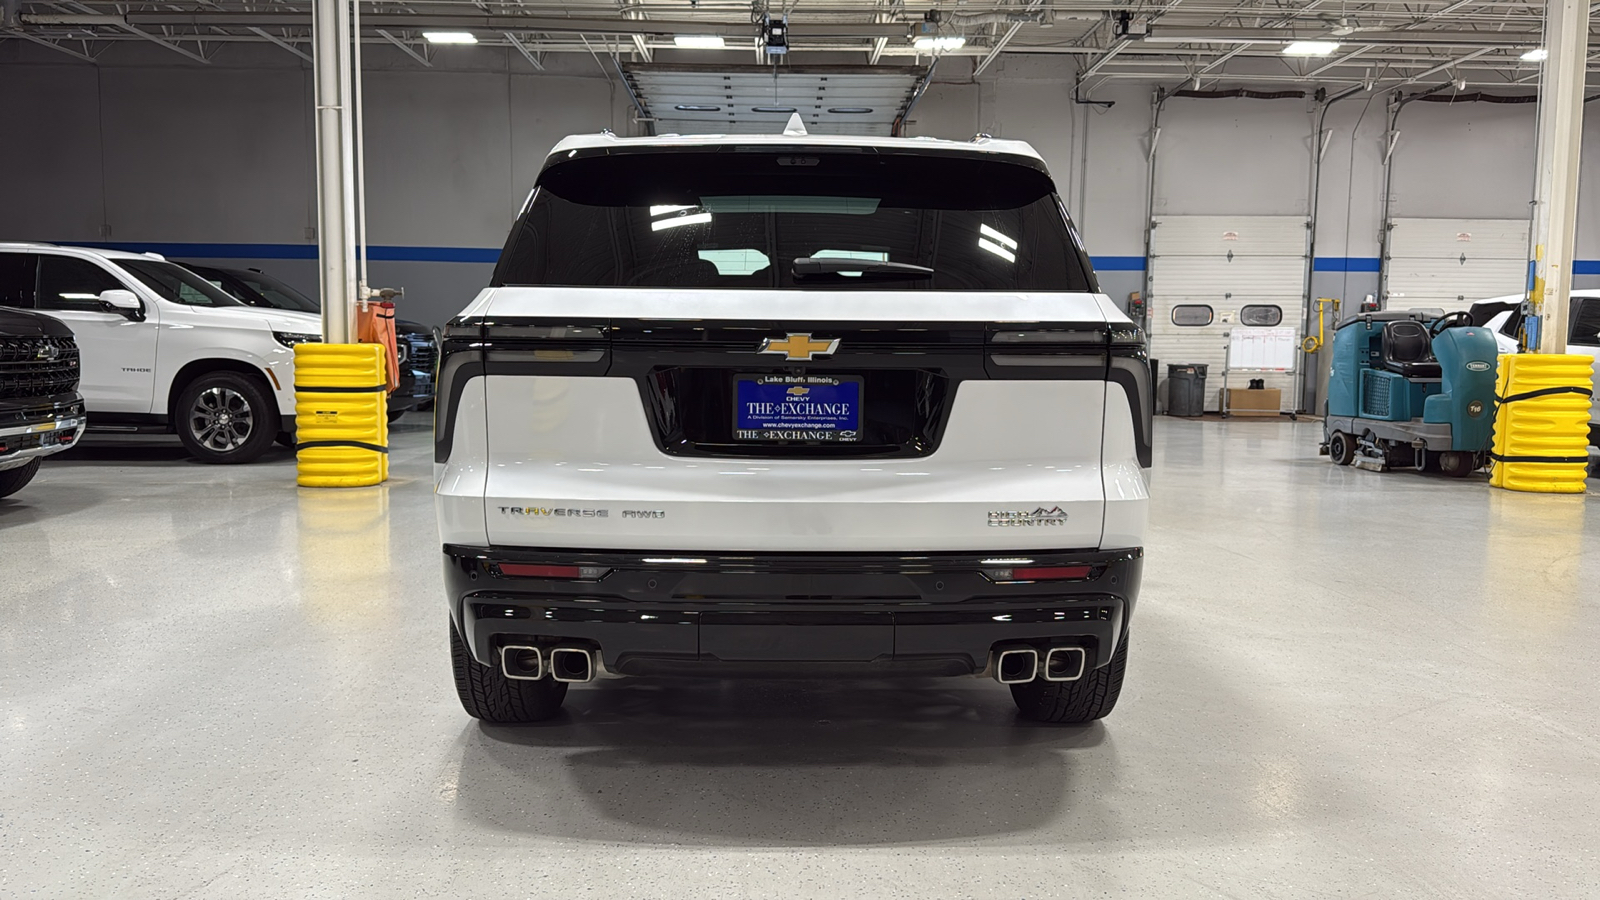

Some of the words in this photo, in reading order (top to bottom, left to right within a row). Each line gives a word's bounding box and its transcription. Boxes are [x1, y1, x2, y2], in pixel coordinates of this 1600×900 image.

[785, 376, 805, 384] Bluff,
[746, 402, 774, 415] THE
[781, 402, 849, 416] EXCHANGE
[737, 430, 759, 439] THE
[769, 430, 833, 440] EXCHANGE
[498, 506, 609, 518] TRAVERSE
[622, 509, 666, 519] AWD
[988, 518, 1068, 527] COUNTRY
